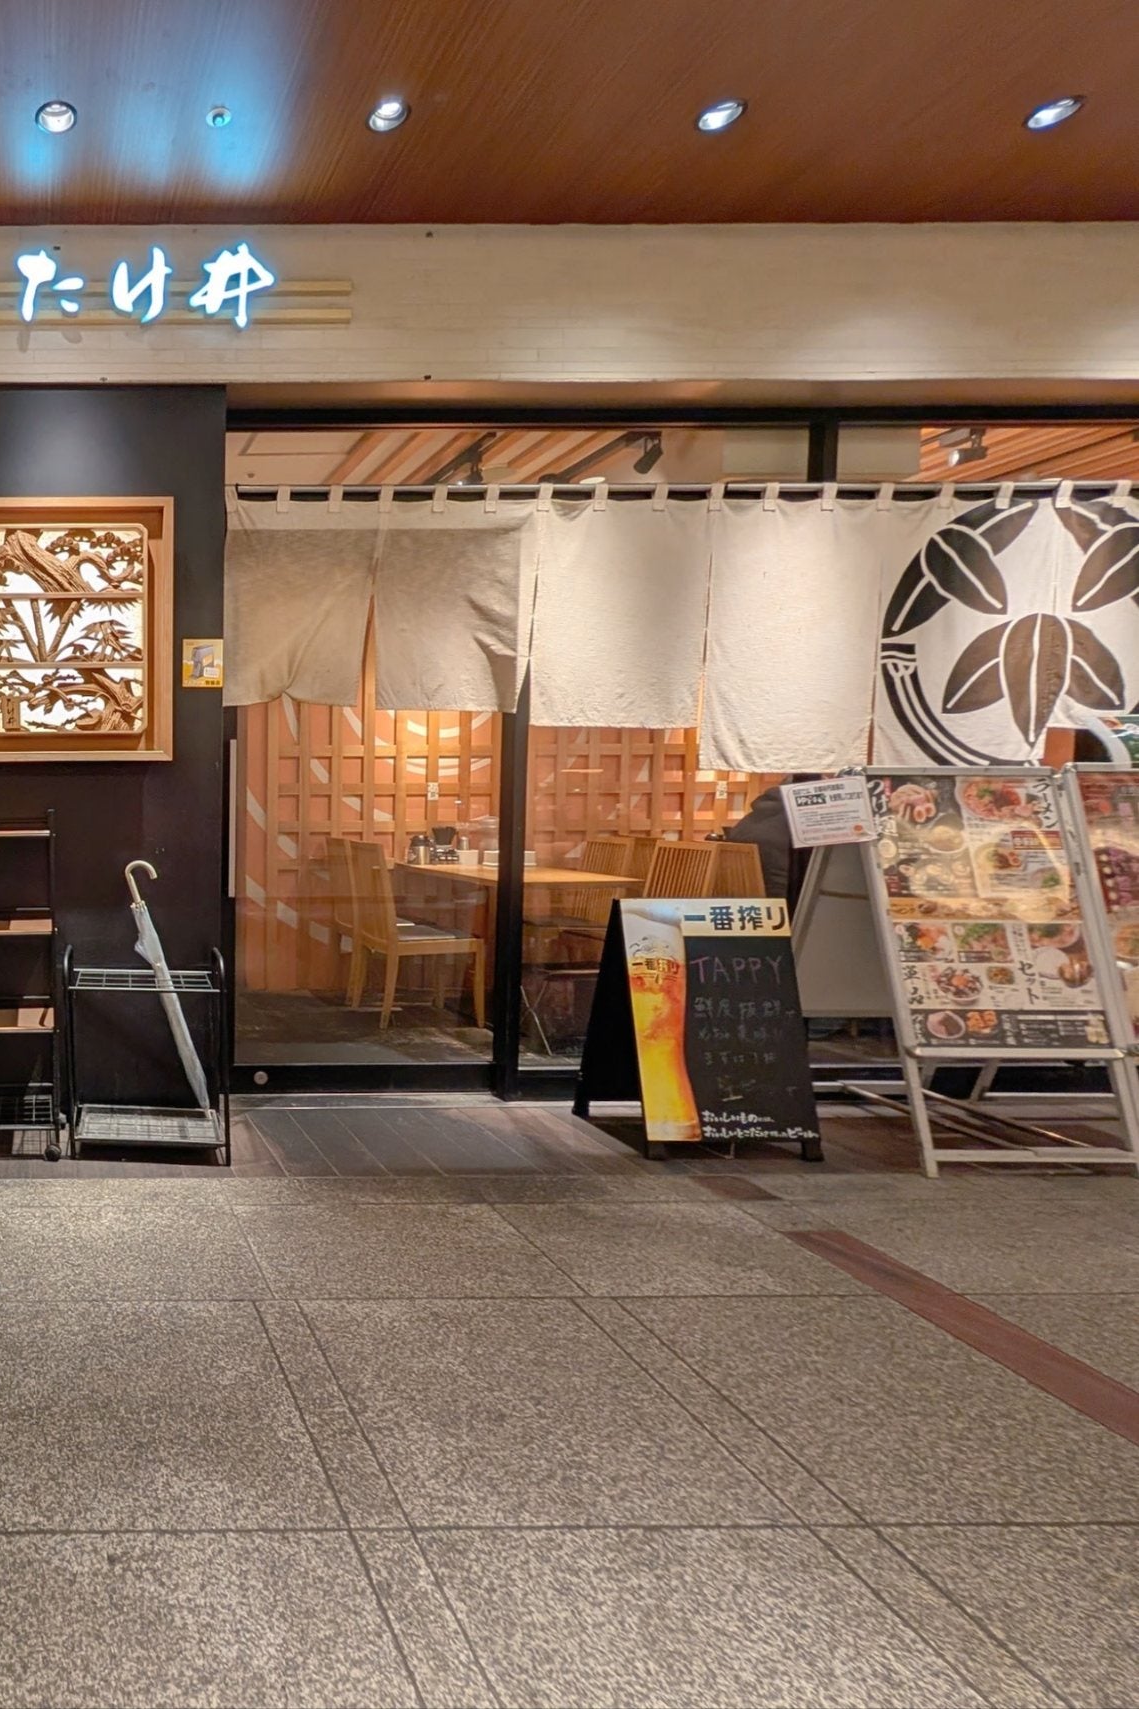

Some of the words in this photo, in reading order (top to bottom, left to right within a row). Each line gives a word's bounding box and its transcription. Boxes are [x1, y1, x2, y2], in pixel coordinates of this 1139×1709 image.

[16, 243, 275, 328] たけ井
[1032, 778, 1059, 829] ラーメン
[683, 905, 786, 932] 一番搾り
[689, 955, 782, 984] TAPPY
